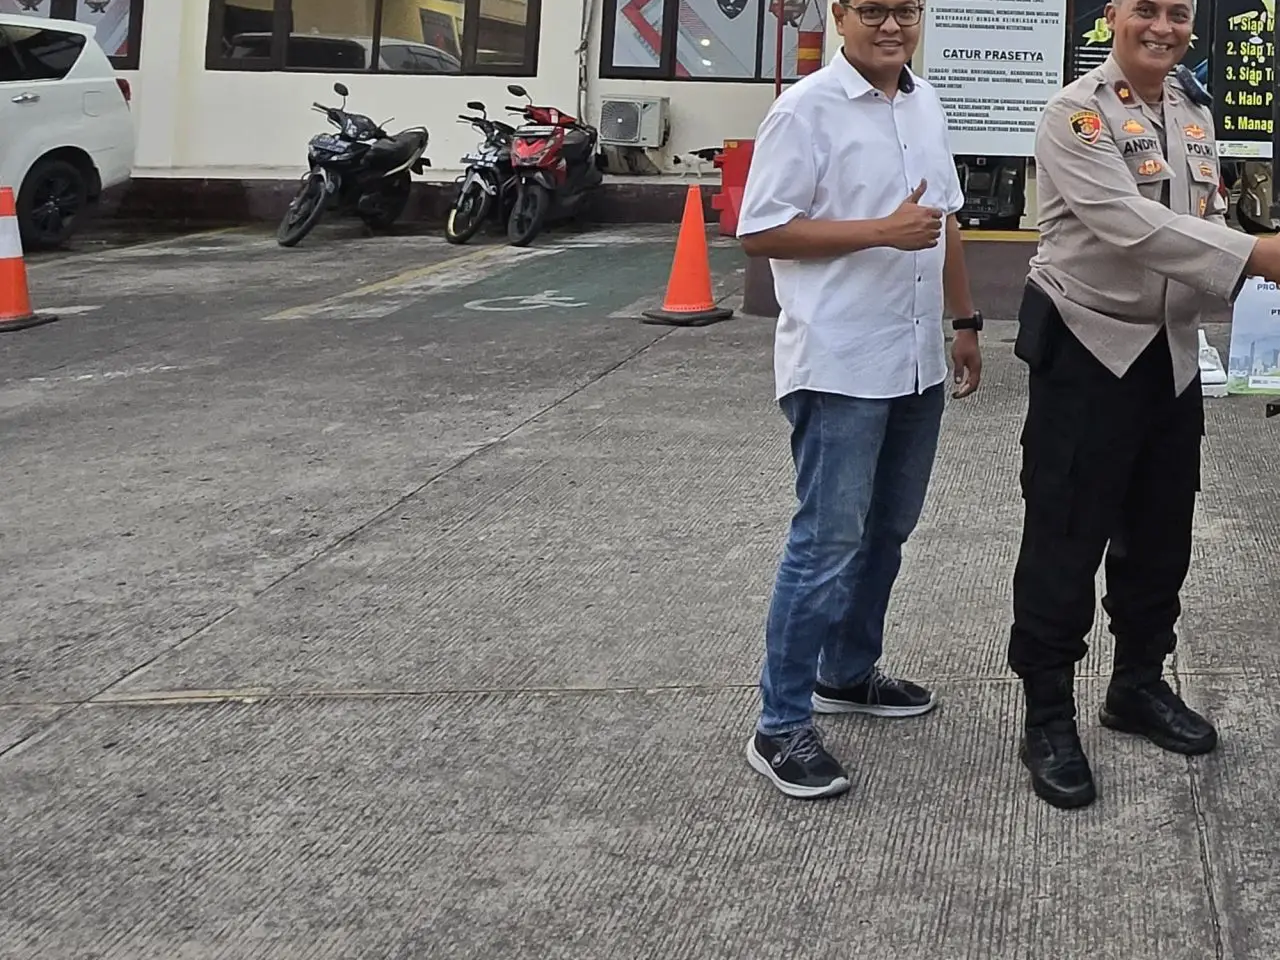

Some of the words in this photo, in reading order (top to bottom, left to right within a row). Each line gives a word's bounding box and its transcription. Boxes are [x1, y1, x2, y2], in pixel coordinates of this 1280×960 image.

[1240, 17, 1264, 33] Siap
[942, 48, 982, 60] CATUR
[984, 50, 1044, 61] PRASETYA
[1226, 41, 1237, 55] 2.
[1240, 42, 1264, 58] Siap
[1225, 66, 1236, 81] 3.
[1239, 67, 1263, 84] Siap
[1224, 90, 1236, 105] 4.
[1238, 91, 1263, 106] Halo
[1224, 115, 1236, 130] 5.
[1237, 116, 1274, 134] Manag
[1271, 308, 1280, 316] PT
